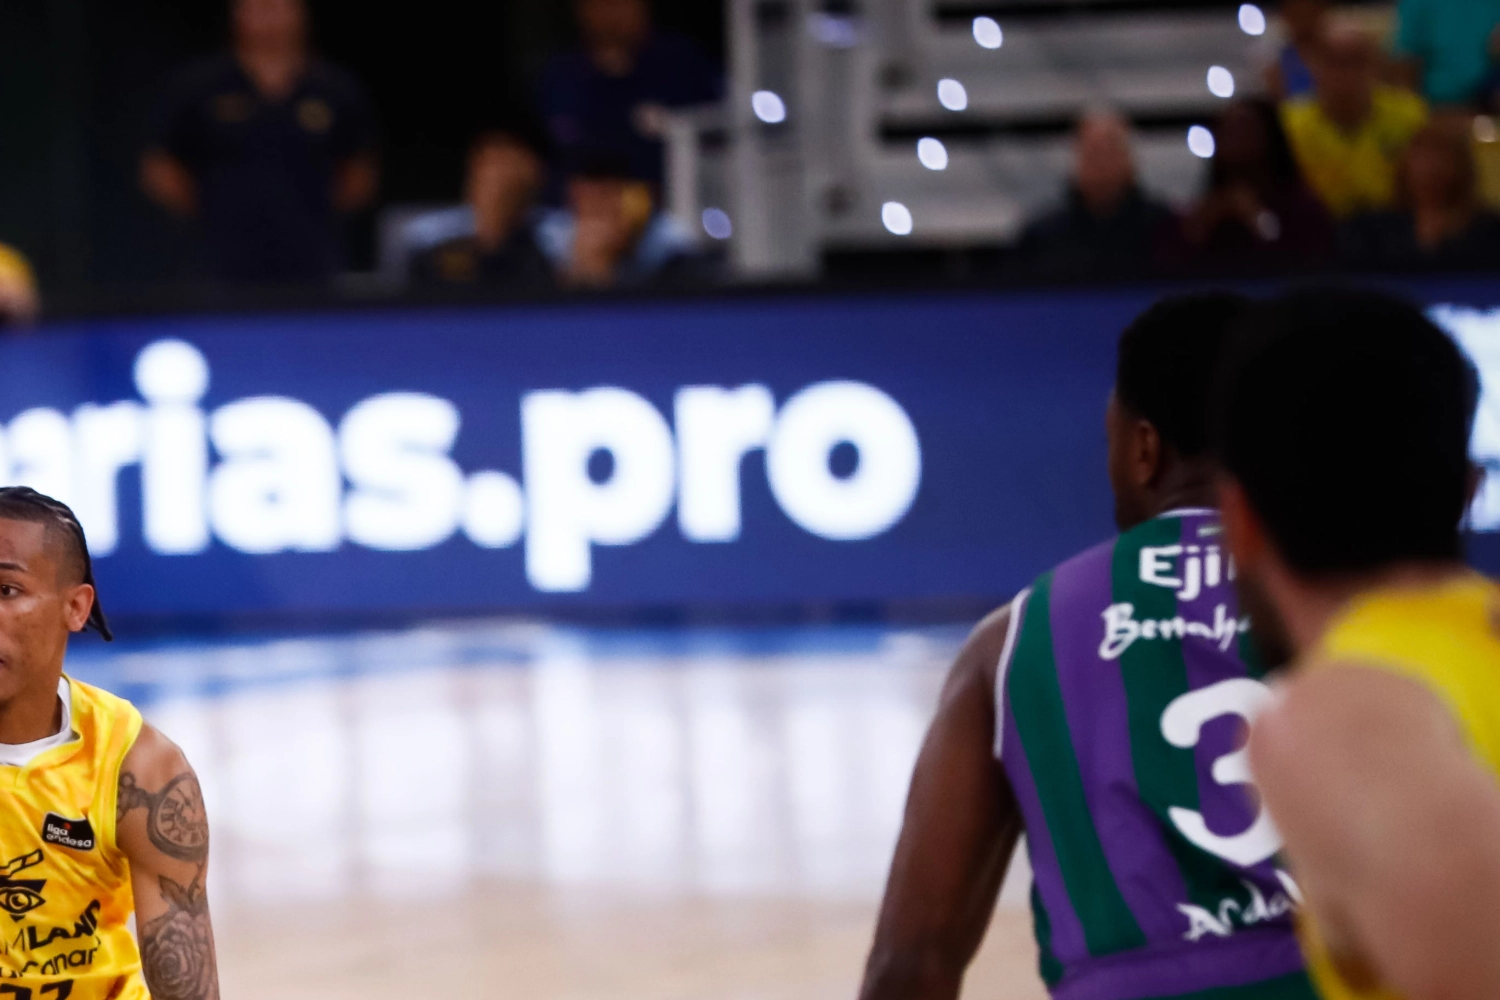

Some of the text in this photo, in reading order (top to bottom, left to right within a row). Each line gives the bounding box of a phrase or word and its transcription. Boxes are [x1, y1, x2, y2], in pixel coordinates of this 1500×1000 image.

[1139, 544, 1237, 601] Eji
[1160, 677, 1285, 867] 3
[46, 833, 92, 848] endesa
[47, 823, 68, 836] liga
